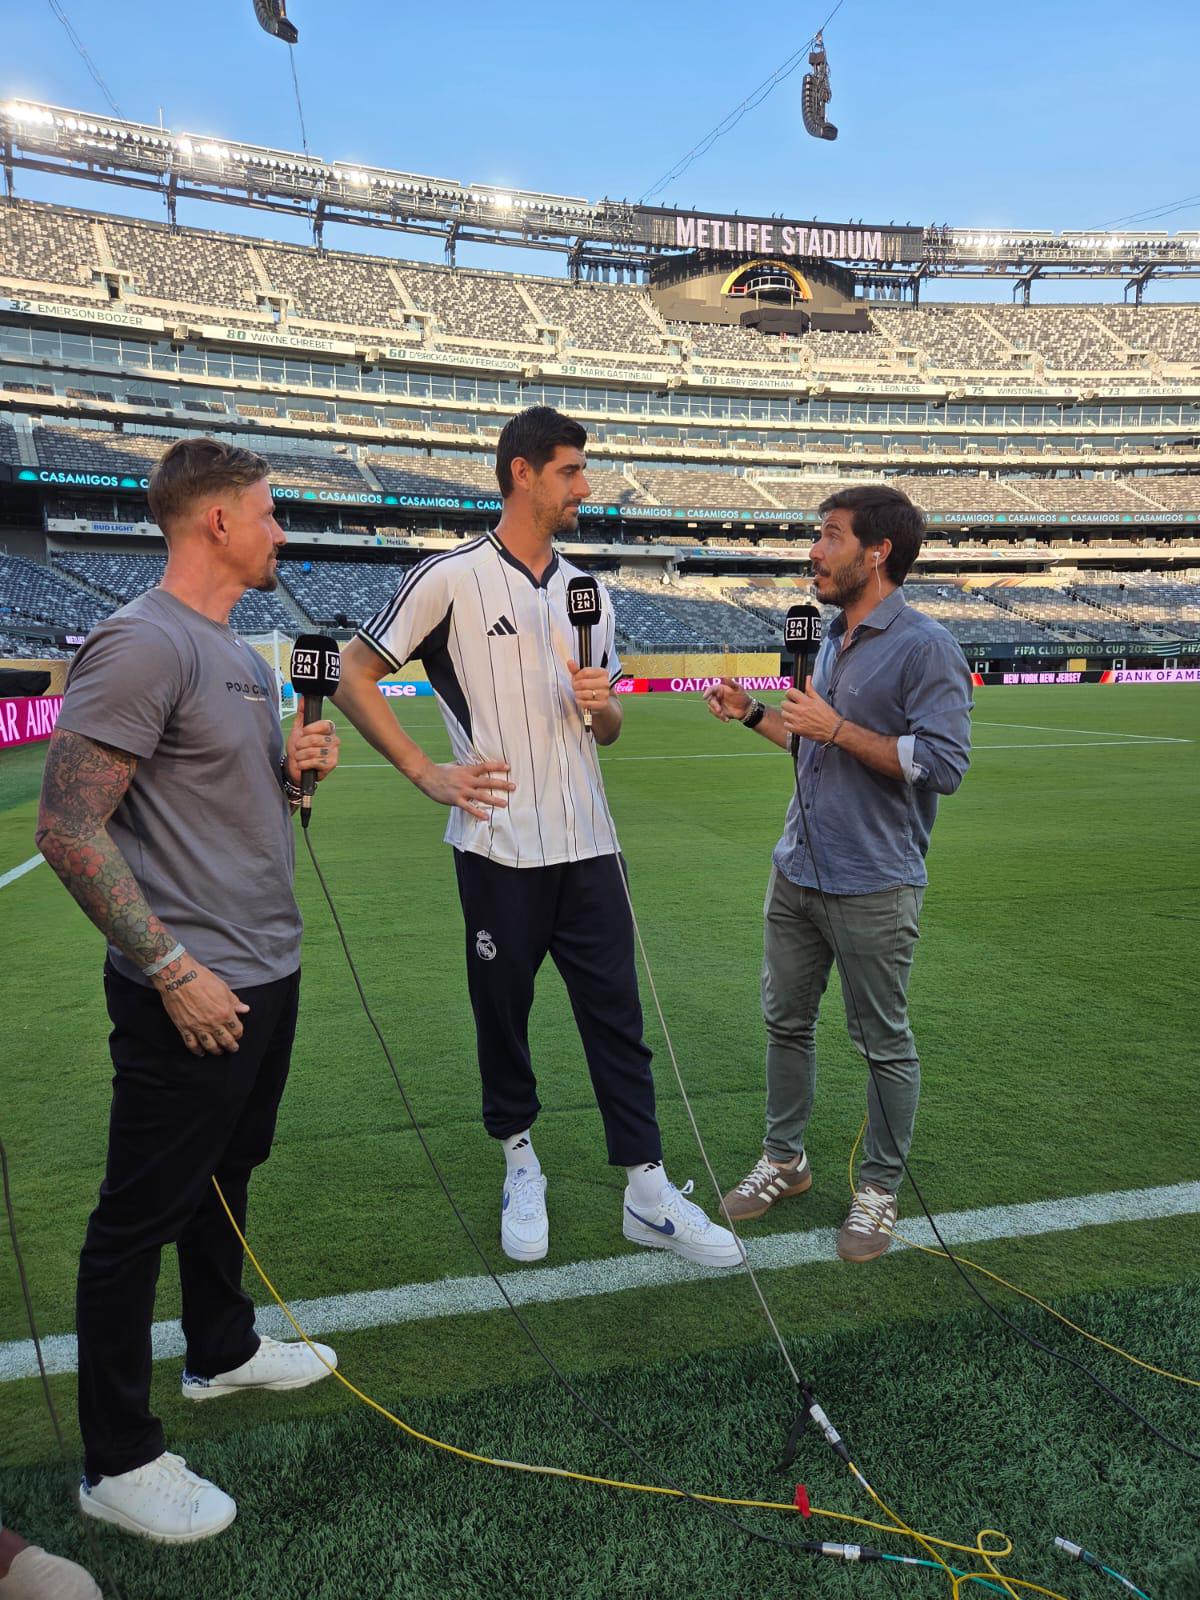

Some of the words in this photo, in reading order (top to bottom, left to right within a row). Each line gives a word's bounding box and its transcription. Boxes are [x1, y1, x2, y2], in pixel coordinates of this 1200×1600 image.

[676, 216, 774, 253] METLIFE
[781, 226, 882, 261] STADIUM
[38, 304, 96, 320] EMERSON
[98, 312, 143, 326] BOOZER
[226, 329, 246, 340] 80
[251, 333, 289, 345] WAYNE
[290, 338, 334, 350] CHREBET
[389, 349, 406, 358] 60
[475, 358, 520, 369] FERGUSON
[561, 365, 577, 375] 99
[580, 367, 606, 377] MARK
[607, 370, 652, 381] GASTINEAU
[720, 378, 746, 387] LARRY
[748, 380, 794, 389] GRANTHAM
[40, 471, 119, 487] CASAMIGOS
[319, 491, 383, 504] CASAMIGOS
[400, 495, 460, 508] CASAMIGOS
[620, 507, 672, 517] CASAMIGOS
[687, 509, 739, 519] CASAMIGOS
[753, 511, 804, 521] CASAMIGOS
[945, 514, 994, 522] CASAMIGOS
[1008, 514, 1057, 522] CASAMIGOS
[1071, 514, 1120, 522] CASAMIGOS
[1134, 514, 1184, 522] CASAMIGOS
[1014, 646, 1035, 656] FIFA
[1038, 646, 1064, 655] CLUB
[1066, 645, 1104, 655] WORLD
[1105, 645, 1126, 654] CUP
[731, 676, 791, 690] IRWAYS
[1003, 673, 1019, 684] NEW
[1020, 673, 1039, 684] YORK
[1039, 673, 1055, 684] NEW
[1056, 672, 1082, 683] JERSEY
[1117, 671, 1152, 681] BANK
[1156, 671, 1172, 681] OF
[165, 970, 198, 992] ROMEO
